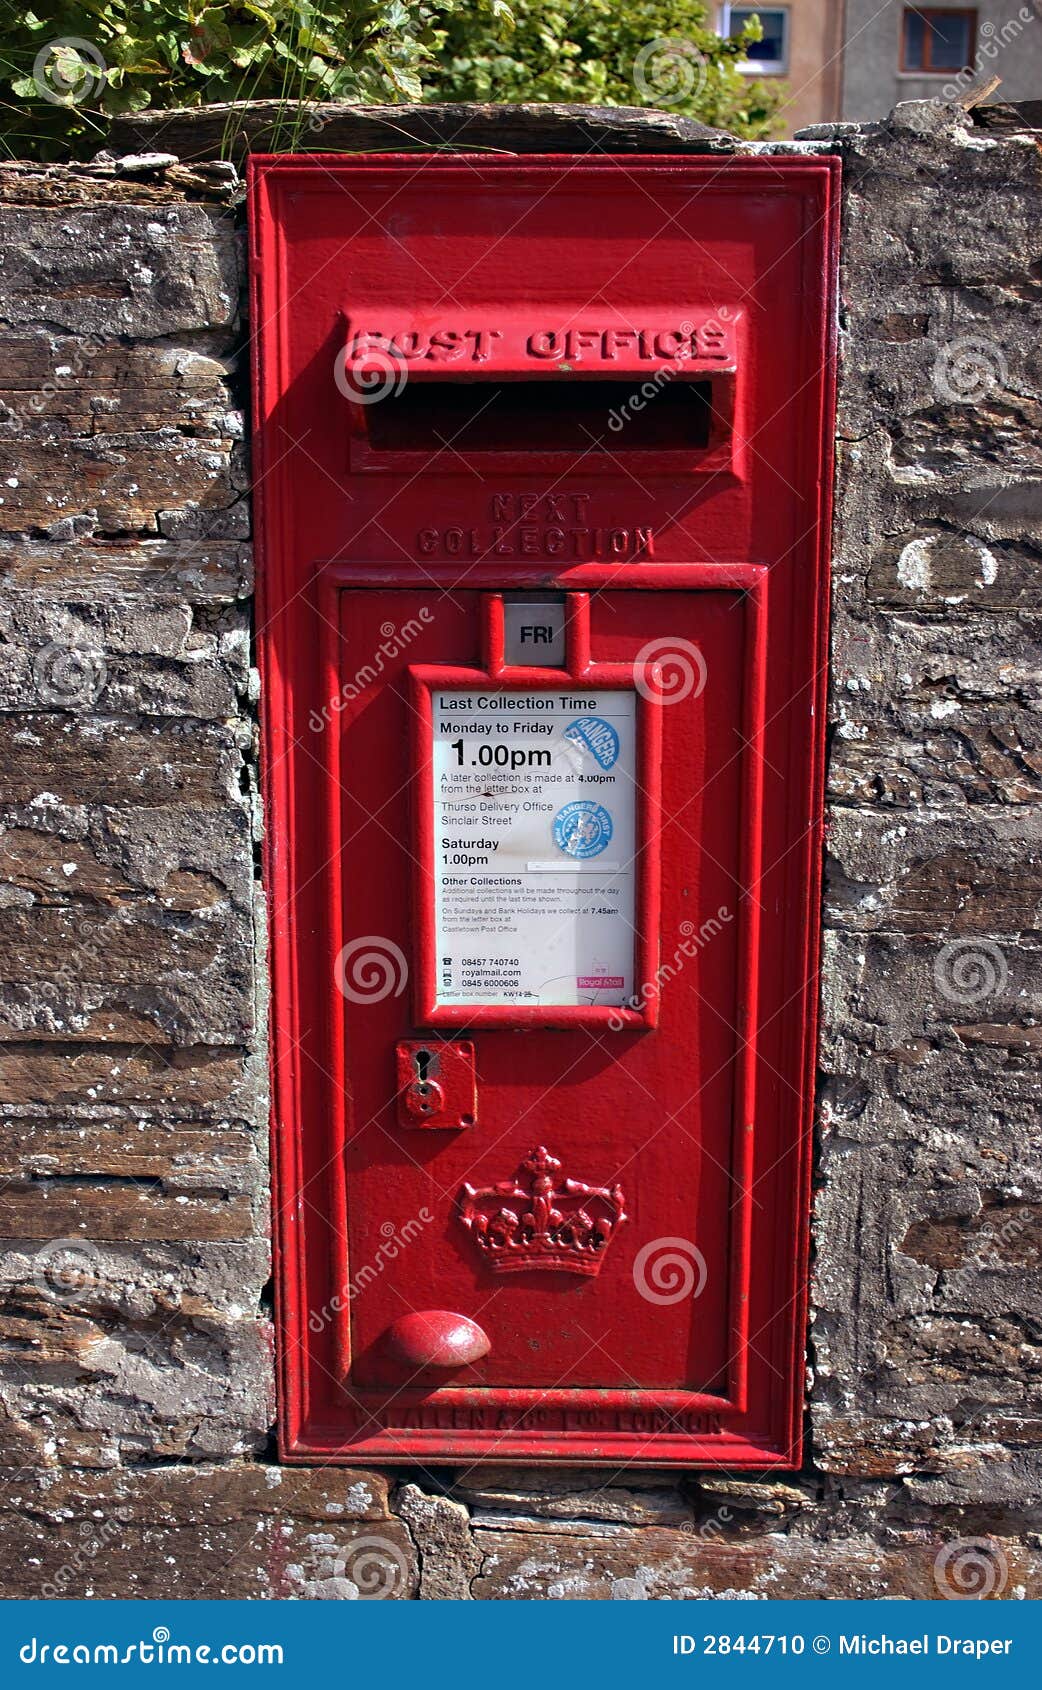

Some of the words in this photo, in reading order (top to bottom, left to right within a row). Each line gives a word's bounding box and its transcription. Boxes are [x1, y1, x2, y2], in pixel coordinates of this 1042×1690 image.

[350, 329, 503, 362] POST
[526, 329, 731, 361] OFFICE
[491, 492, 591, 524] NEXT
[416, 526, 656, 558] COLLECTION
[520, 626, 553, 643] FRI
[439, 697, 472, 710] Last
[477, 697, 554, 710] Collection
[560, 697, 597, 710] Time
[440, 723, 492, 735] Monday
[496, 723, 509, 733] to
[514, 723, 554, 735] Friday
[577, 718, 616, 766] RANGERS
[451, 739, 551, 770] 1.00pm
[441, 774, 448, 782] A
[451, 774, 471, 782] later
[474, 774, 520, 782] collection
[524, 774, 532, 782] is
[535, 774, 562, 782] made
[565, 774, 575, 782] at
[578, 774, 615, 784] 4.00pm
[441, 785, 463, 793] from
[466, 785, 481, 793] the
[484, 785, 508, 793] letter
[512, 785, 529, 793] box
[533, 785, 542, 793] at
[441, 802, 476, 811] Thurso
[480, 802, 519, 813] Delivery
[523, 802, 553, 811] Office
[441, 816, 479, 825] Sinclair
[482, 816, 512, 825] Street
[441, 838, 499, 850] Saturday
[442, 855, 488, 866] 1.00pm
[442, 877, 467, 886] Other
[470, 877, 522, 886] Collections
[453, 908, 482, 916] Sundays
[517, 908, 546, 916] Holidays
[461, 958, 487, 966] 08457
[489, 958, 519, 966] 740740
[461, 969, 521, 977] royalmail.com
